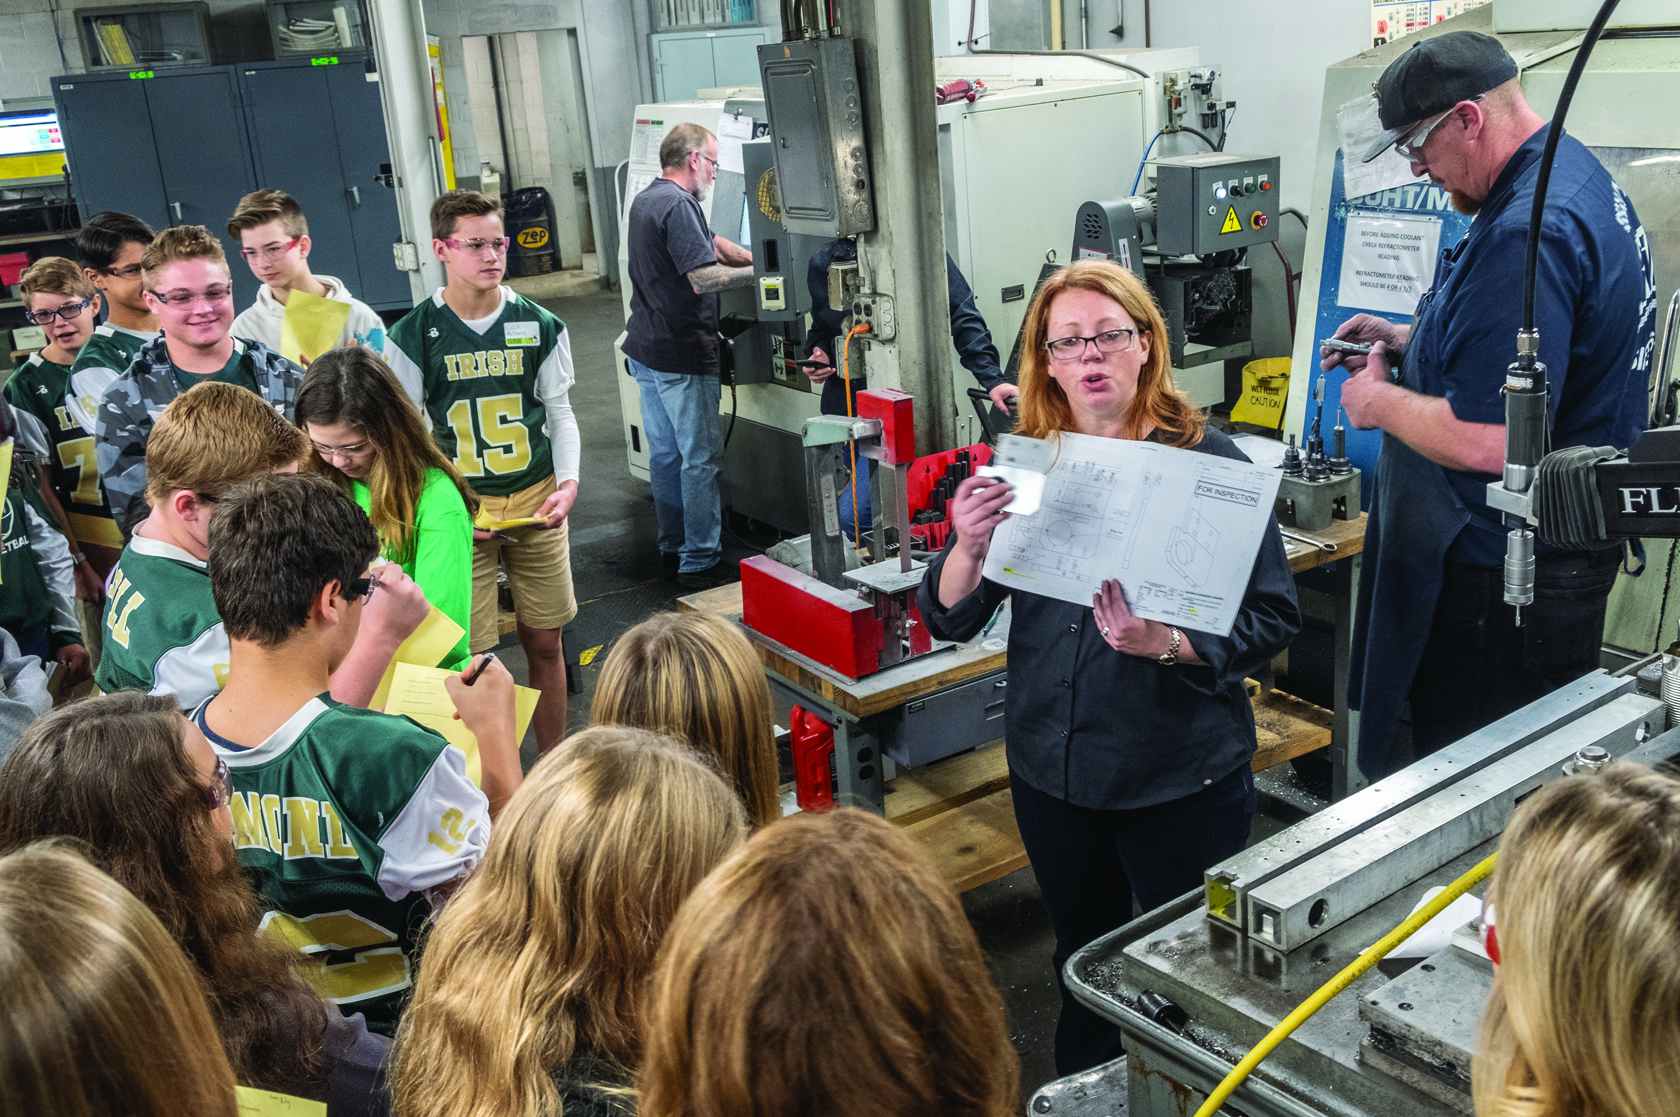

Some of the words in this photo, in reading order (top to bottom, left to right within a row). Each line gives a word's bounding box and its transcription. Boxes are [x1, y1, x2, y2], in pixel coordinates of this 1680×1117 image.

[1396, 274, 1421, 282] READ
[444, 349, 524, 381] IRISH
[1250, 395, 1281, 409] CAUTION
[447, 393, 532, 477] 15
[1197, 485, 1213, 494] FOR
[1213, 488, 1257, 503] INSPECTION
[1618, 487, 1680, 513] FL
